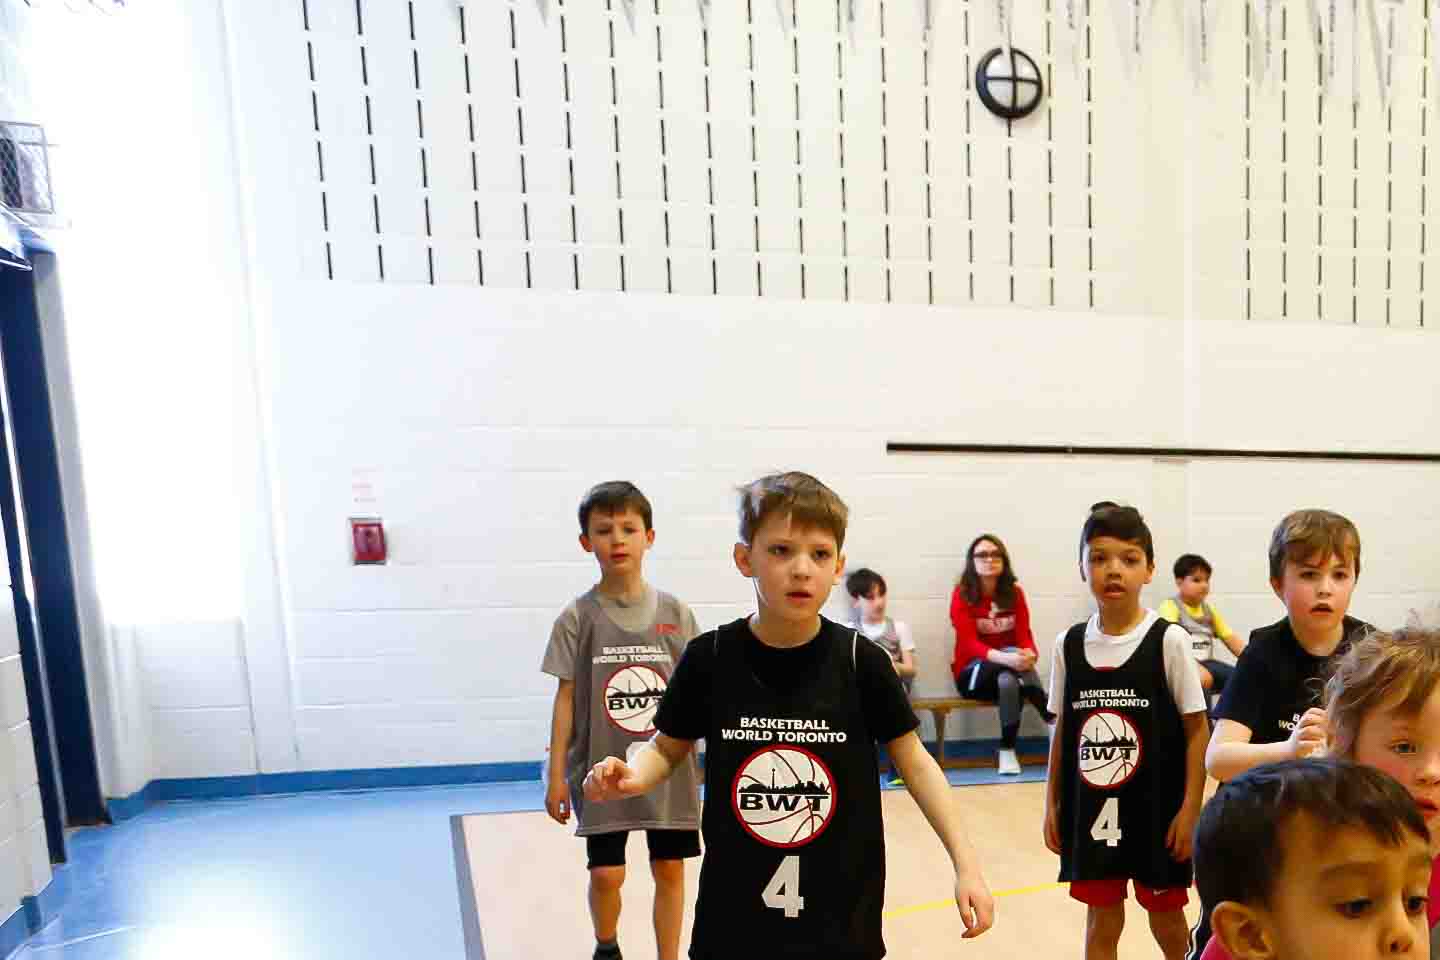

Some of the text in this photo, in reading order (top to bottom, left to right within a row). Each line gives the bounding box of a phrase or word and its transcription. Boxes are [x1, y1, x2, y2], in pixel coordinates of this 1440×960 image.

[1080, 689, 1137, 699] BASKETBALL
[1099, 699, 1149, 707] TORONTO
[740, 717, 829, 730] BASKETBALL
[721, 728, 847, 743] WORLD TORONTO
[1080, 748, 1137, 760] BWT
[739, 793, 830, 812] BWT
[1090, 798, 1122, 846] 4
[761, 856, 804, 917] 4
